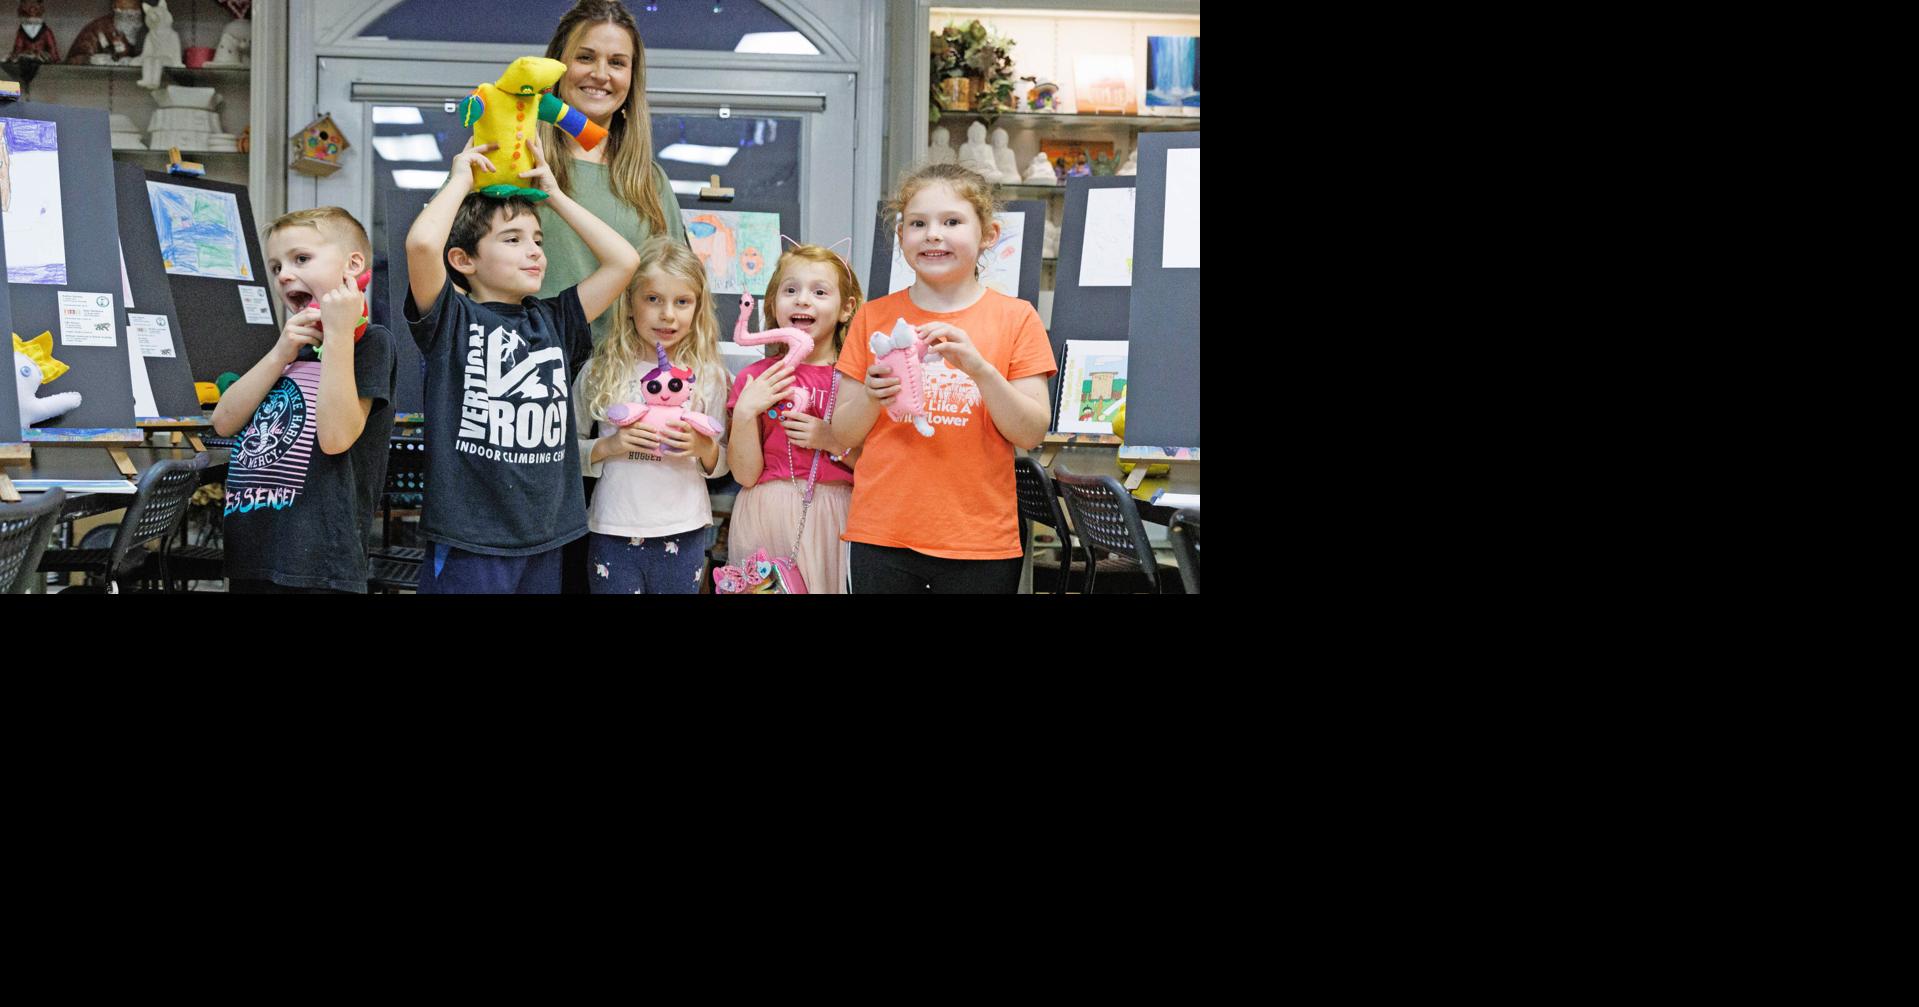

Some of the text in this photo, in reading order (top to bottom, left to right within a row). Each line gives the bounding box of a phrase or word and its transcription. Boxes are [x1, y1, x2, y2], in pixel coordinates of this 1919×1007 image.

[281, 379, 303, 444] STRIKE HARD
[928, 399, 958, 413] Like
[960, 402, 972, 415] A
[236, 449, 279, 469] NO MERCY
[455, 440, 501, 461] INDOOR
[503, 452, 551, 464] CLIMBING
[239, 487, 296, 513] SENSEI
